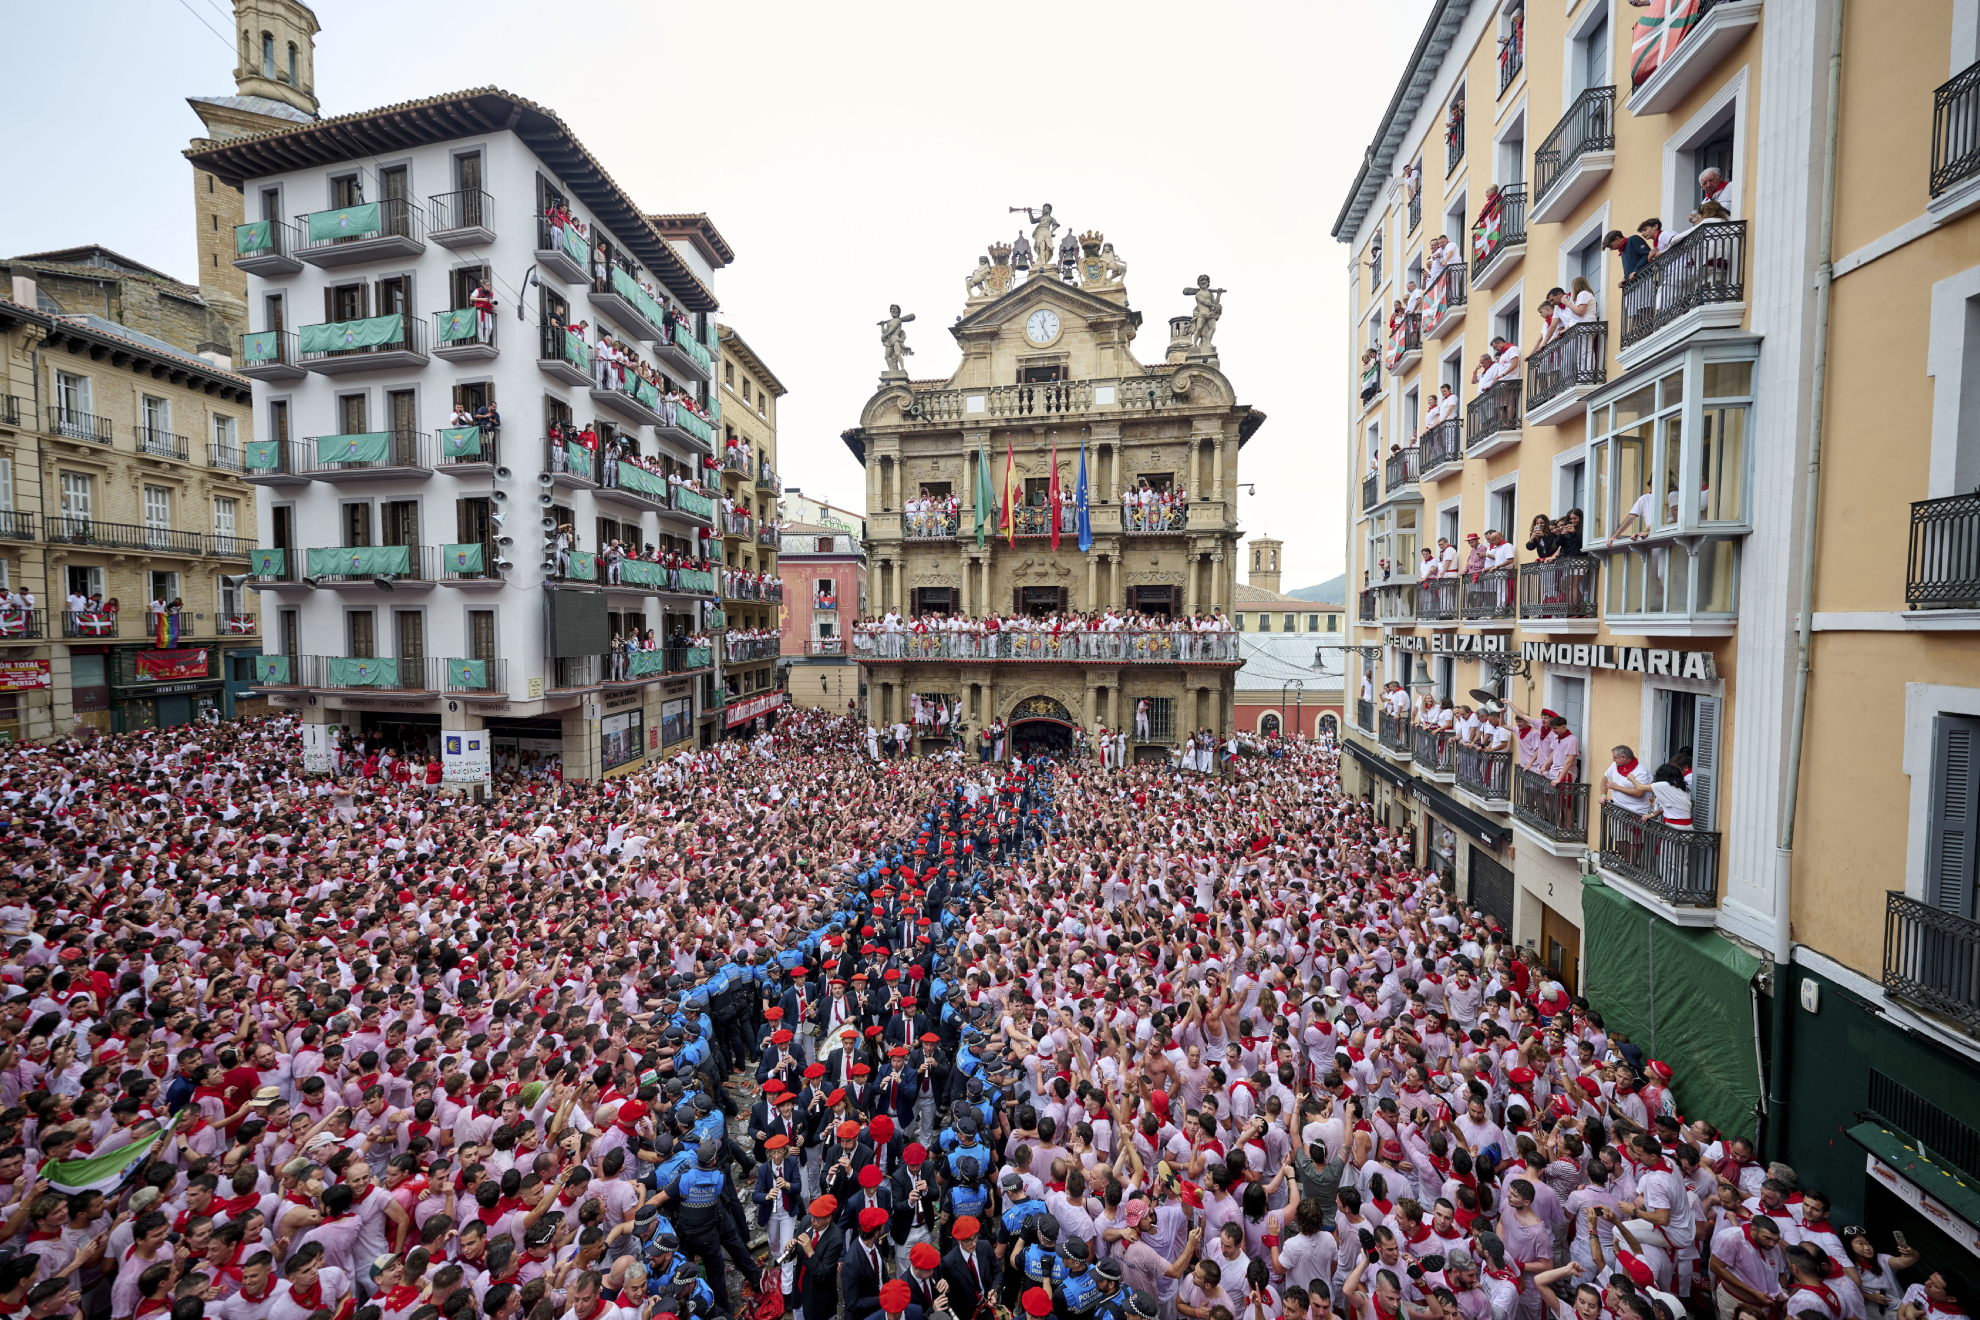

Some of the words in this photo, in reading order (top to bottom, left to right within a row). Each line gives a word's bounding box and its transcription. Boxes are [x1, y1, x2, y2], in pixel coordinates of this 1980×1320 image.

[141, 652, 197, 660] BOCADILLOS
[1383, 634, 1423, 651] AGENCIA
[1431, 633, 1505, 657] ELIZARI
[1521, 641, 1707, 680] INMOBILIARIA
[273, 695, 300, 703] WELCOME
[341, 698, 374, 707] BIENVENIDO
[389, 700, 405, 708] ONGI
[478, 704, 511, 712] BIENVENUE
[73, 705, 108, 713] CALZADOS
[1548, 882, 1554, 897] 2
[957, 1200, 982, 1208] POLICIA
[1031, 1260, 1061, 1272] POIA
